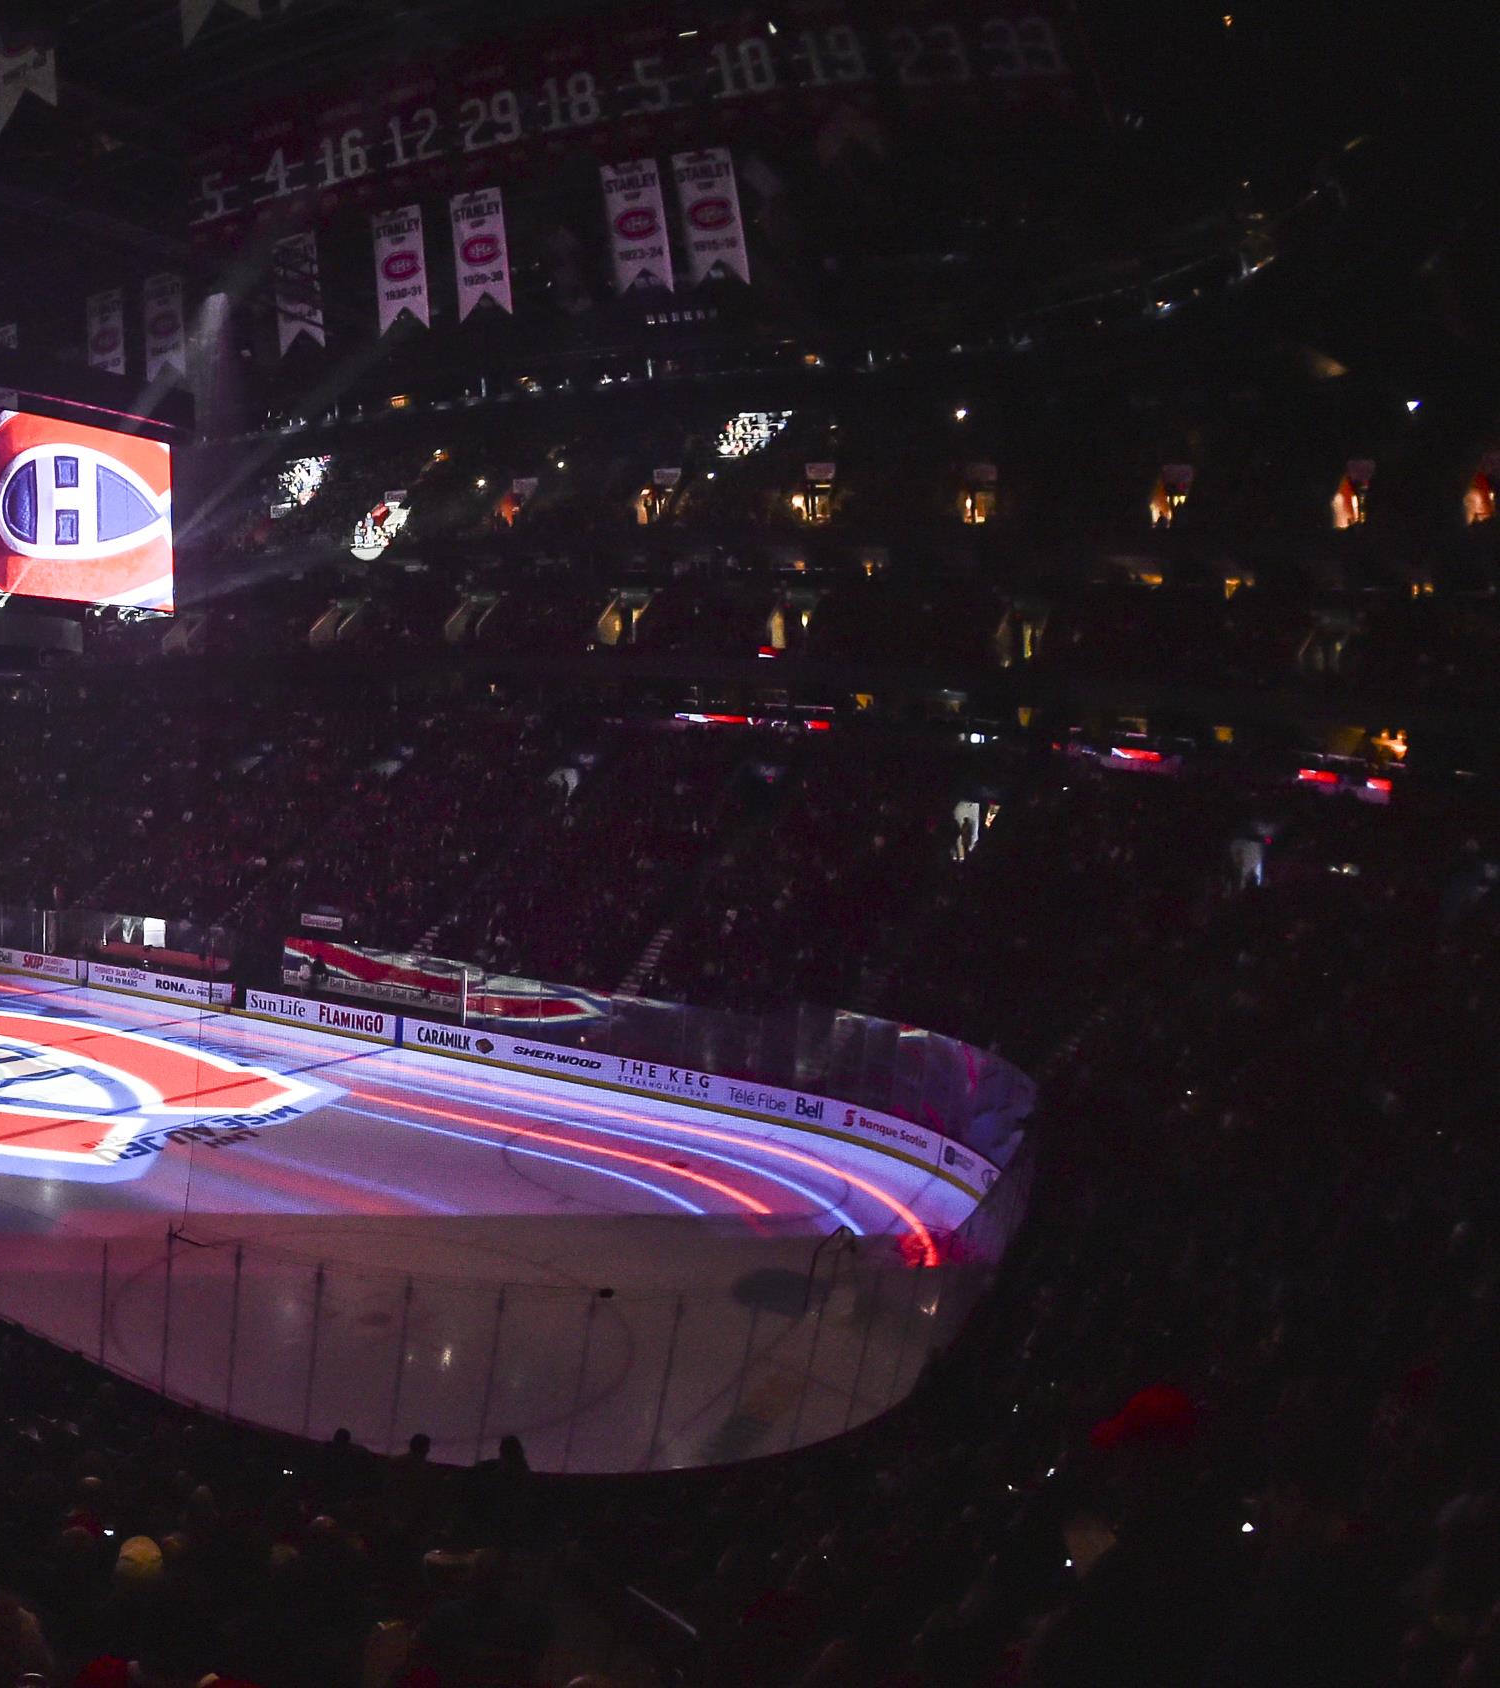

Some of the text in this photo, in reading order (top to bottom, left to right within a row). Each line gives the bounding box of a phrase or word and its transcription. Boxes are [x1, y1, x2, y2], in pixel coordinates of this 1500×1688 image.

[319, 128, 368, 188] 16
[387, 107, 444, 169] 12
[459, 89, 522, 153] 29
[540, 71, 601, 132] 18
[710, 37, 777, 99] 10
[799, 25, 870, 86] 19
[604, 173, 657, 193] STANLEY
[452, 202, 501, 223] STANLEY
[375, 218, 421, 240] STANLEY
[22, 954, 44, 970] SKIP
[122, 978, 138, 988] MARS
[250, 994, 306, 1018] Sun Life
[318, 1004, 384, 1034] FLAMINGO
[417, 1026, 471, 1051] CARAMILK
[513, 1046, 602, 1070] SHER-WOOD
[619, 1059, 710, 1089] THE KEG
[728, 1087, 787, 1112] Télé Fibe
[795, 1096, 824, 1120] Bell
[859, 1117, 928, 1149] Banque Scotia
